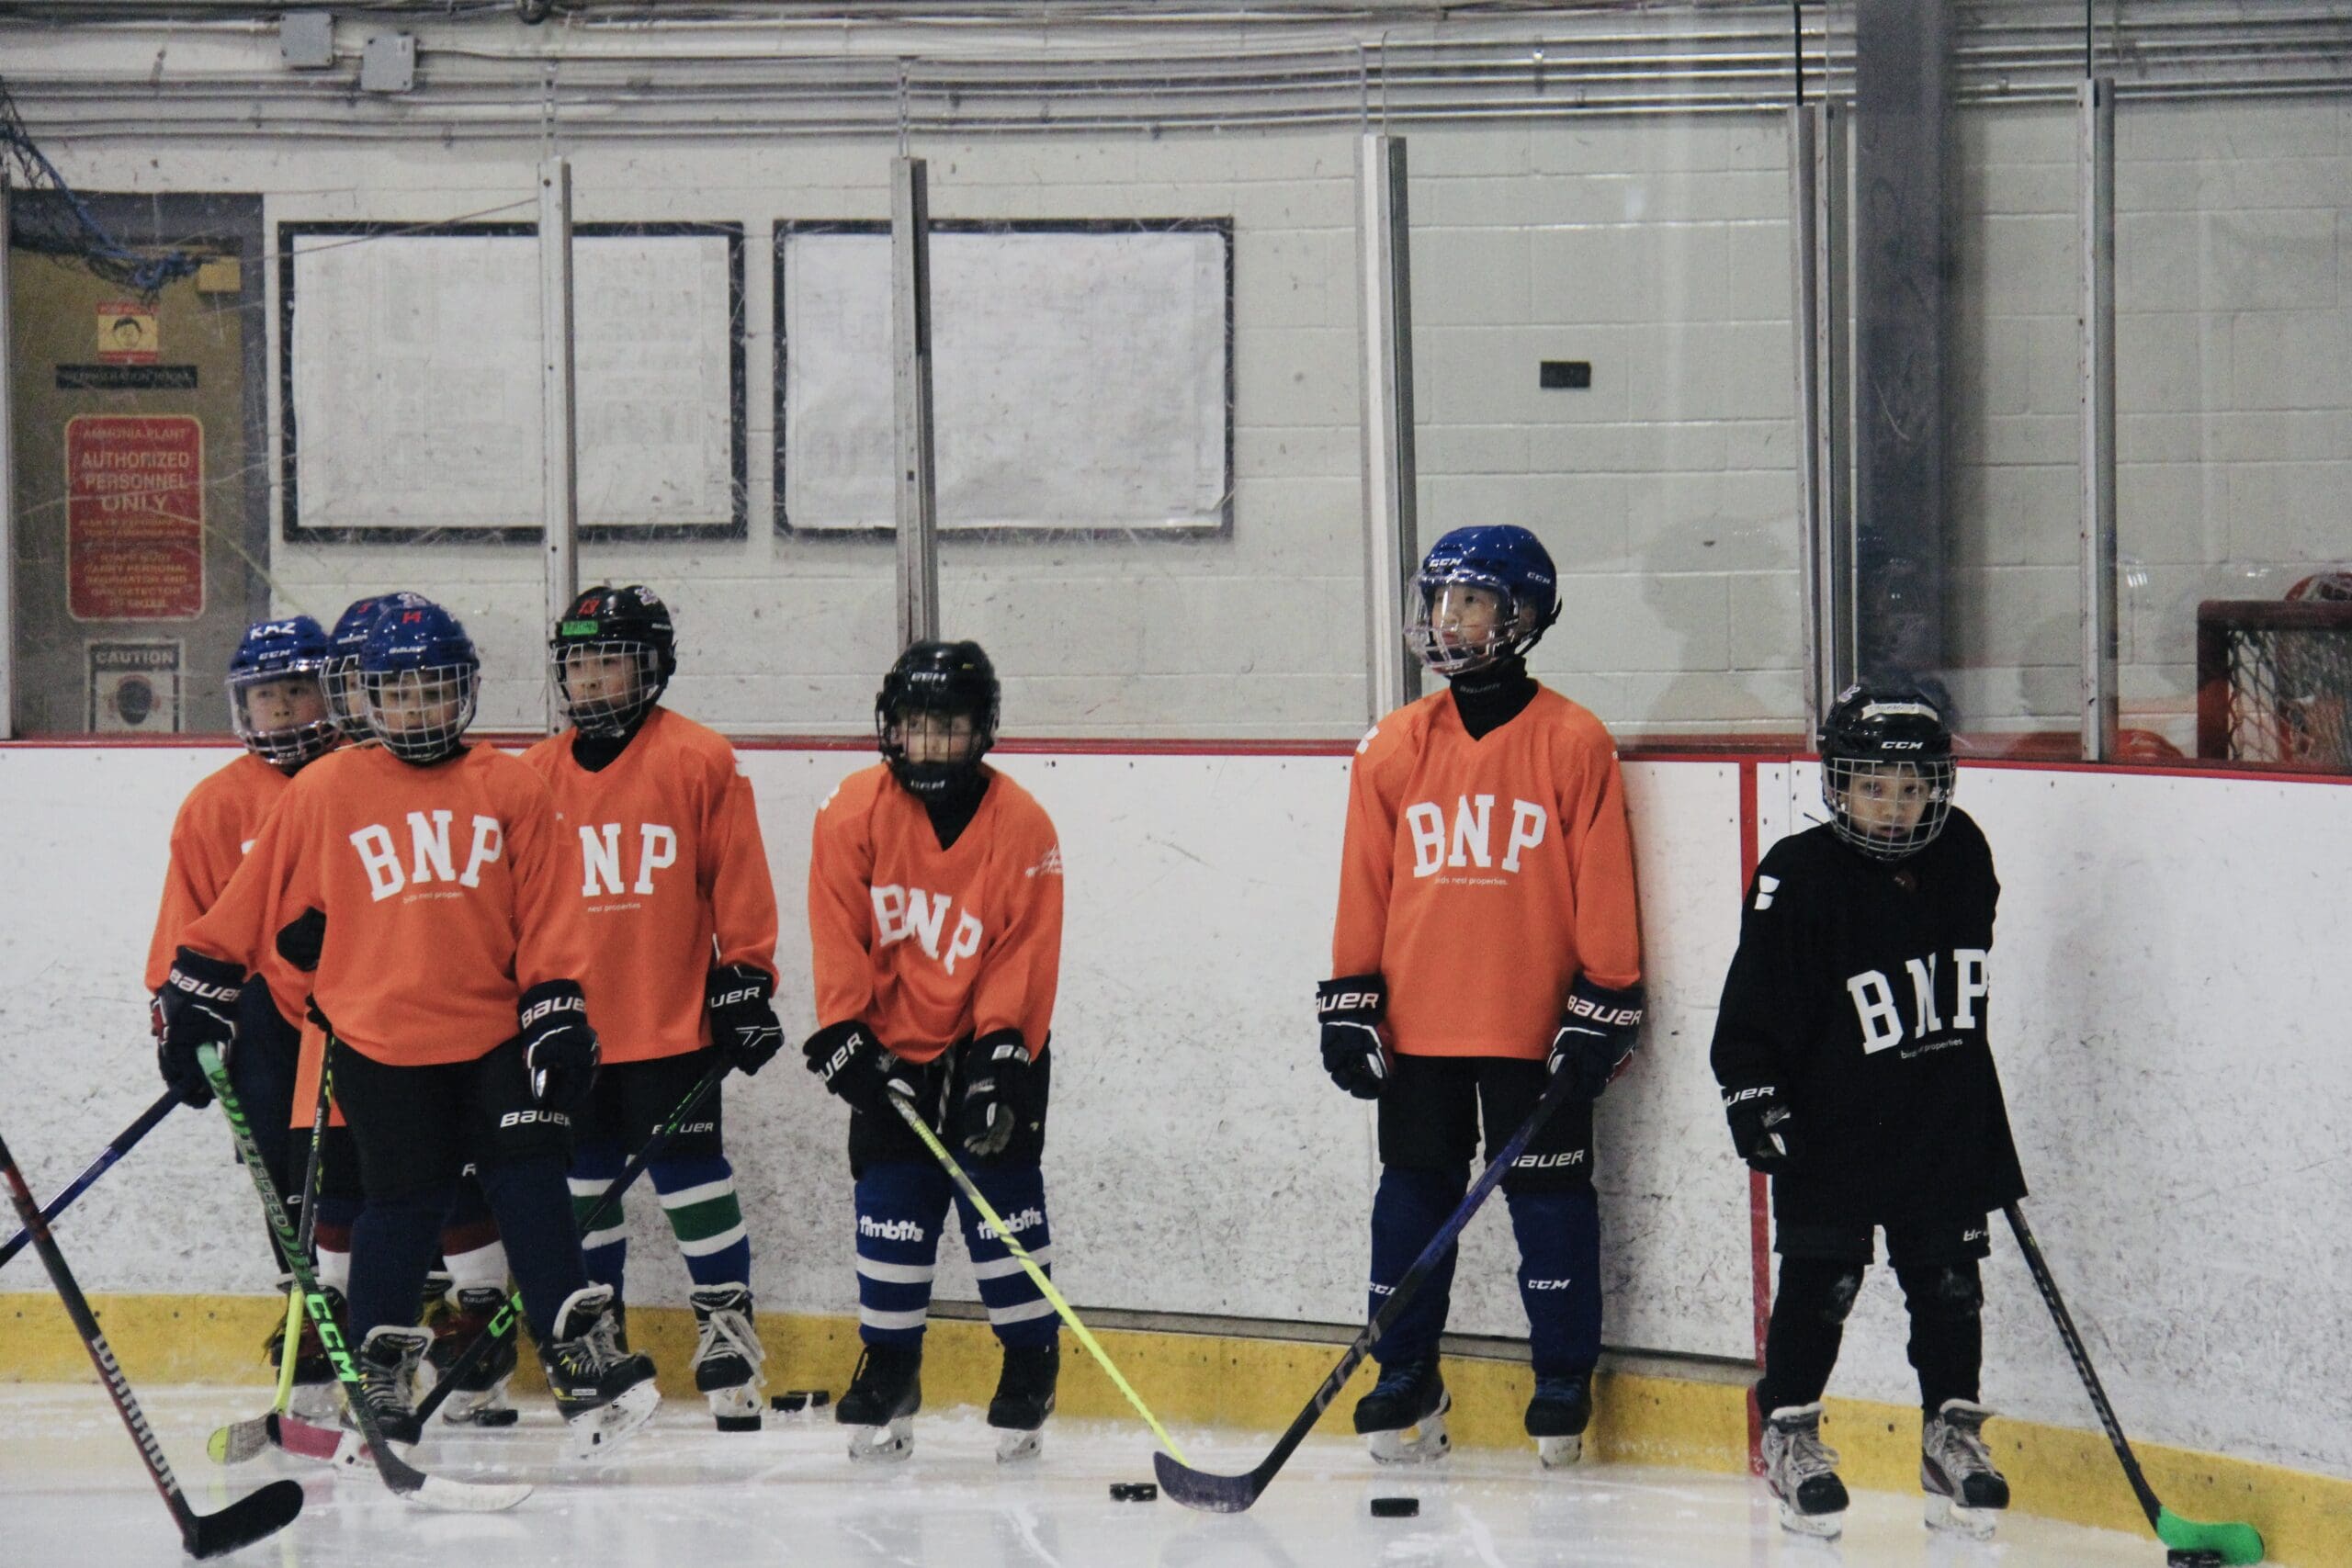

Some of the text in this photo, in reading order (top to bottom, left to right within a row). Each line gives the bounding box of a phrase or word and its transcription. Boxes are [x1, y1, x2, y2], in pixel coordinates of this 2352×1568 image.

[82, 451, 190, 468] AUTHORIZED
[85, 473, 189, 491] PERSONNEL
[101, 493, 168, 512] ONLY
[1429, 558, 1463, 569] CCM
[1526, 571, 1551, 585] CCM
[96, 649, 174, 664] CAUTION
[258, 649, 291, 660] CCM
[910, 672, 947, 682] CCM
[1881, 740, 1924, 750] CCM
[1406, 794, 1548, 879] BNP
[349, 809, 503, 903] BNP
[579, 822, 678, 897] NP
[869, 884, 984, 976] BNP
[711, 986, 761, 1009] UER
[1847, 948, 1990, 1055] BNP
[521, 997, 585, 1030] BAUE
[1566, 994, 1643, 1026] BAUER
[819, 1032, 864, 1082] UER
[1726, 1086, 1775, 1107] UER
[860, 1214, 924, 1243] timbits
[1528, 1279, 1571, 1291] CCM
[306, 1293, 360, 1382] CCM
[92, 1334, 179, 1497] WARRIOR
